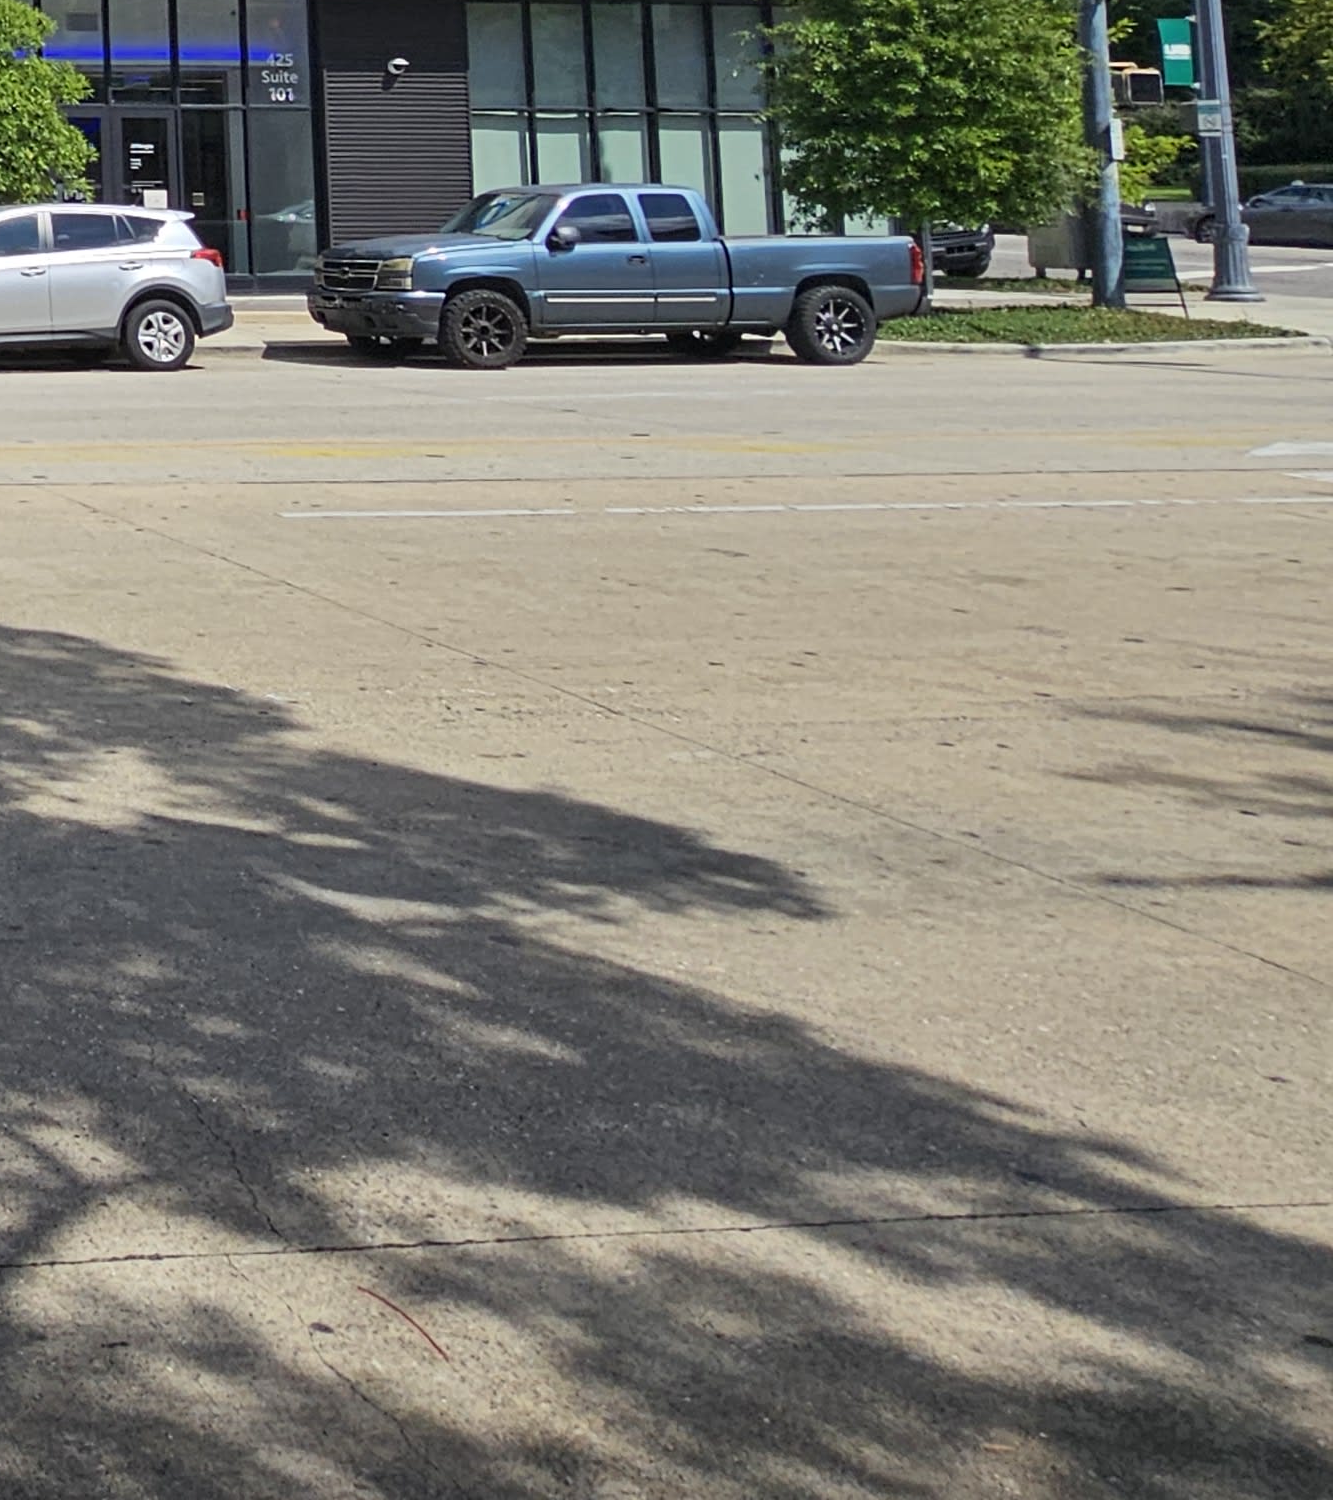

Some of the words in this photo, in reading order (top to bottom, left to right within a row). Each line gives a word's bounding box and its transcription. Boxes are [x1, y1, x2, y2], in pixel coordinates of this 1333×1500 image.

[267, 53, 293, 67] 425
[261, 69, 299, 84] Suite
[269, 87, 294, 102] 101
